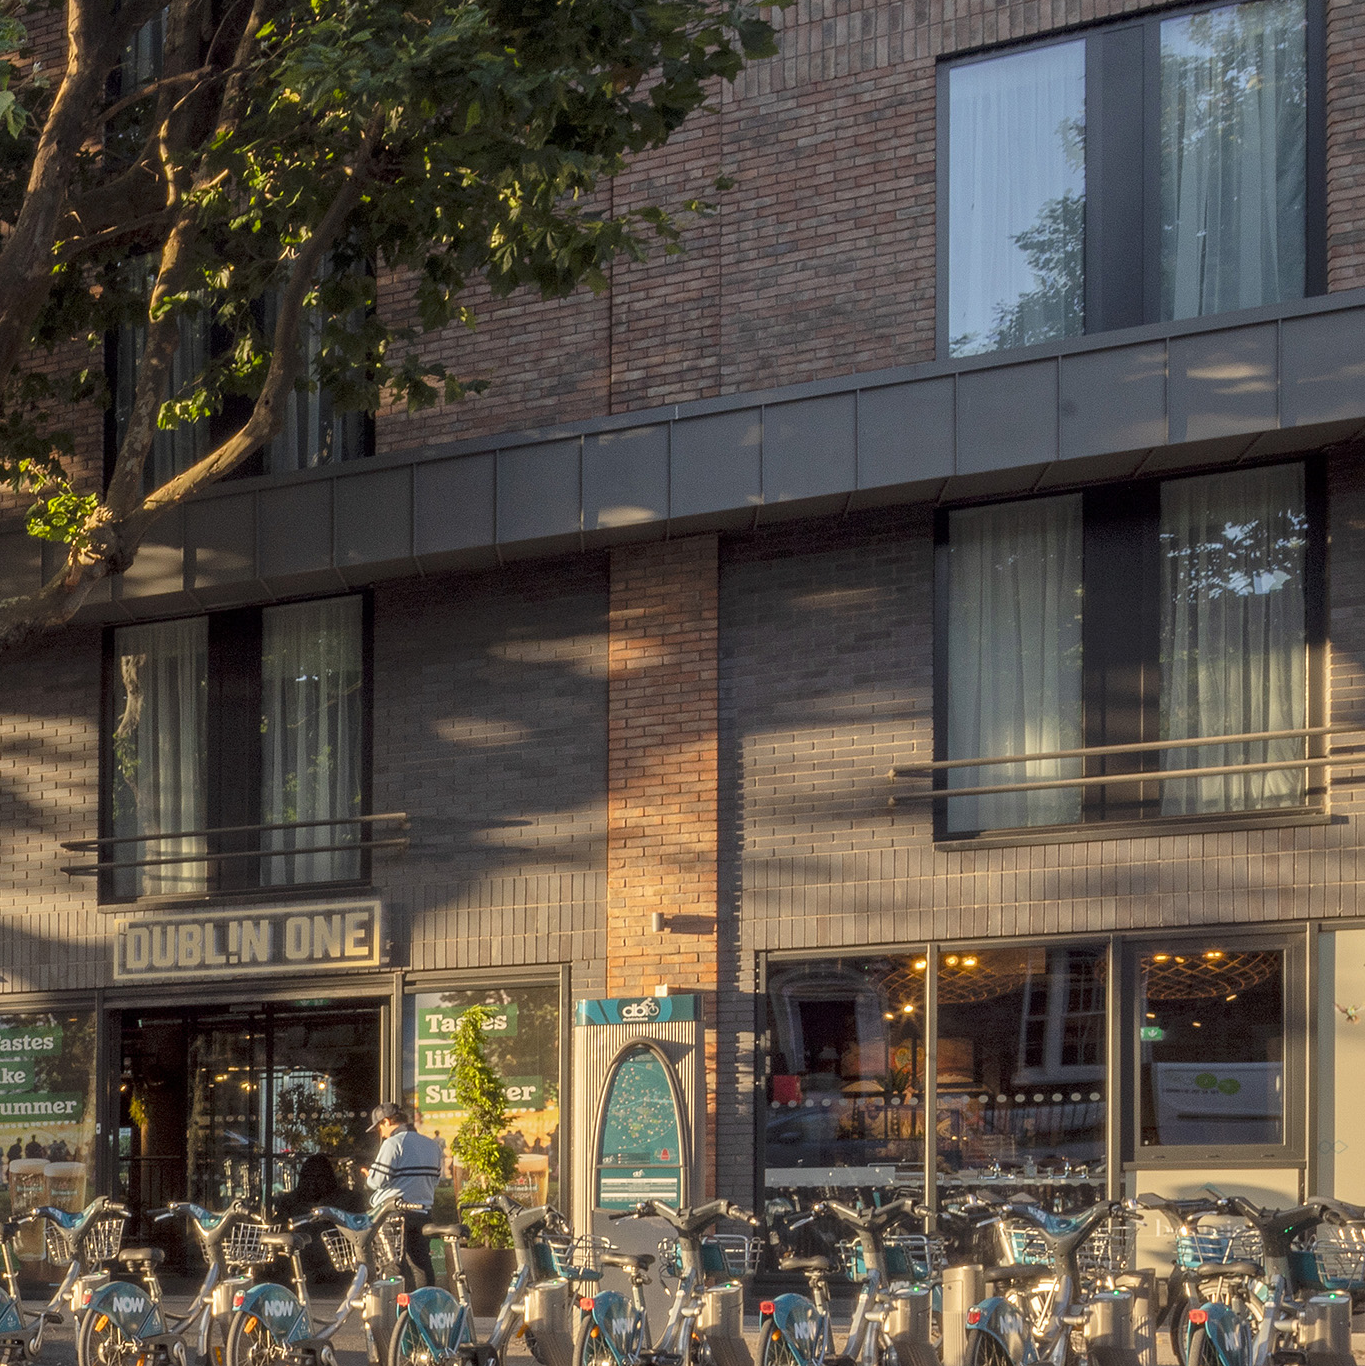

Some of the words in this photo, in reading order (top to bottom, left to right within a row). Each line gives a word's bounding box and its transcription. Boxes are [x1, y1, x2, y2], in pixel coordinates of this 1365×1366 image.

[285, 912, 369, 960] ONE
[425, 1014, 507, 1033] Tases
[425, 1050, 458, 1069] lik
[425, 1085, 537, 1104] Suer
[113, 1297, 145, 1313] NOW
[264, 1301, 294, 1316] NOW
[429, 1312, 455, 1329] NOW
